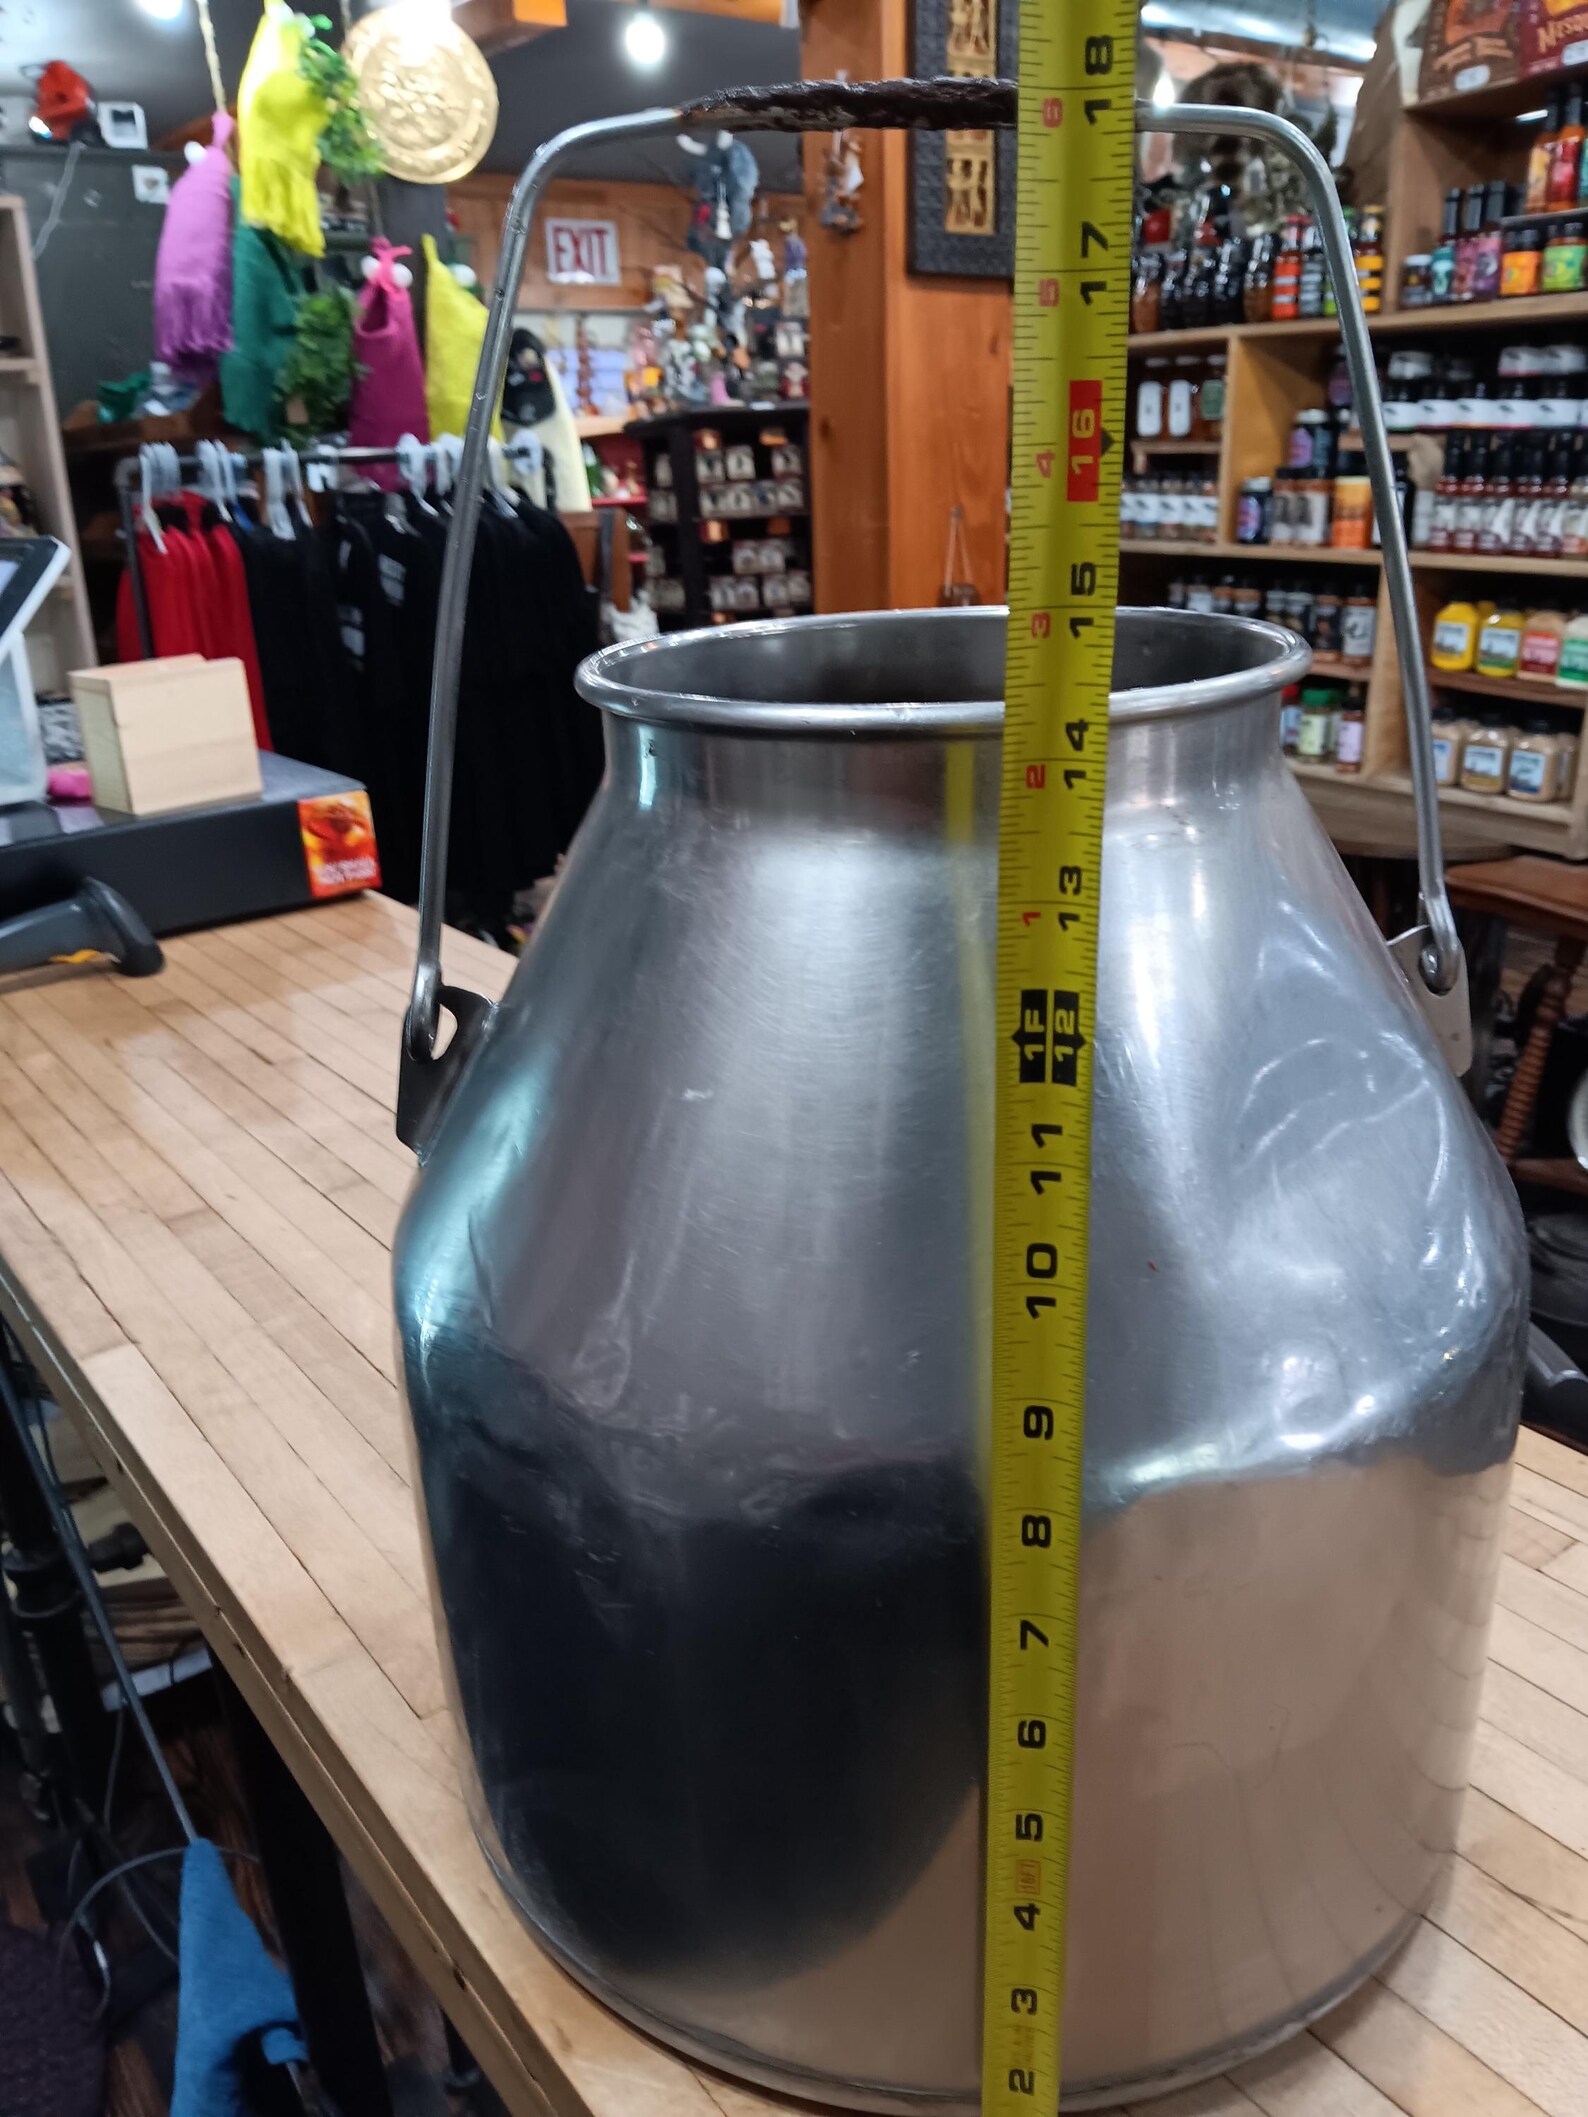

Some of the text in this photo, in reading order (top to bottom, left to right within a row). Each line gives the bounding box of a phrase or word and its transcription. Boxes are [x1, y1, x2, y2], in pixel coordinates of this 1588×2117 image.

[1084, 35, 1114, 126] 18
[553, 226, 608, 275] EXIT
[1080, 221, 1109, 306] 17
[1071, 408, 1096, 475] 16
[1035, 450, 1055, 479] 4
[1069, 561, 1096, 639] 15
[1031, 612, 1051, 639] 3
[1063, 718, 1089, 790] 14
[1025, 764, 1045, 789] 2
[1058, 865, 1082, 931] 13
[1022, 911, 1041, 927] 1
[1024, 1009, 1045, 1061] 1F
[1054, 1008, 1075, 1062] 12
[1030, 1123, 1063, 1196] 11
[1025, 1242, 1058, 1320] 10
[1023, 1405, 1054, 1440] 9
[1021, 1514, 1051, 1549] 8
[1020, 1619, 1049, 1650] 7
[1017, 1719, 1047, 1750] 6
[1015, 1813, 1044, 1842] 5
[1013, 1903, 1041, 1931] 4
[1010, 1988, 1038, 2016] 3
[1008, 2068, 1035, 2097] 2
